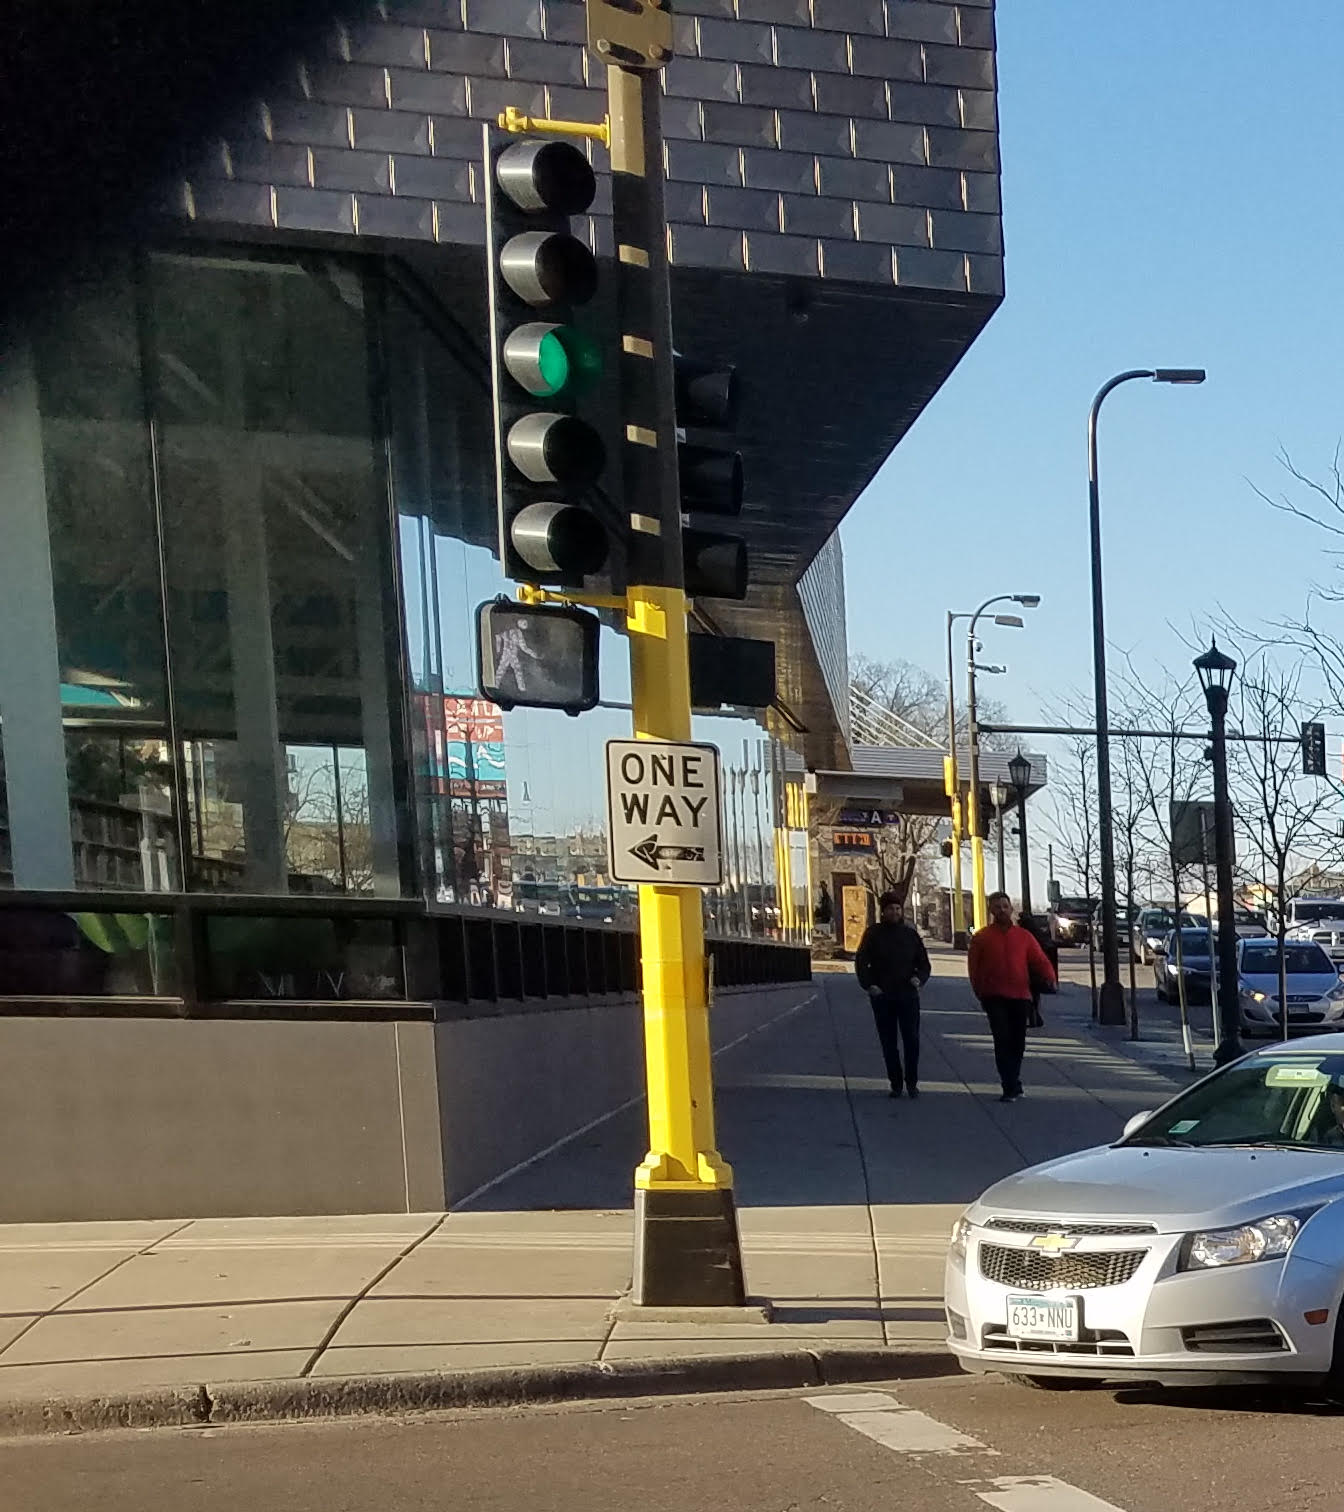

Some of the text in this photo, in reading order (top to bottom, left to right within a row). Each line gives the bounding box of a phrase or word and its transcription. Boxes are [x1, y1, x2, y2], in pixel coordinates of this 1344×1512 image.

[621, 752, 705, 788] ONE
[620, 792, 709, 828] WAY
[1013, 1307, 1073, 1328] 633 NNU
